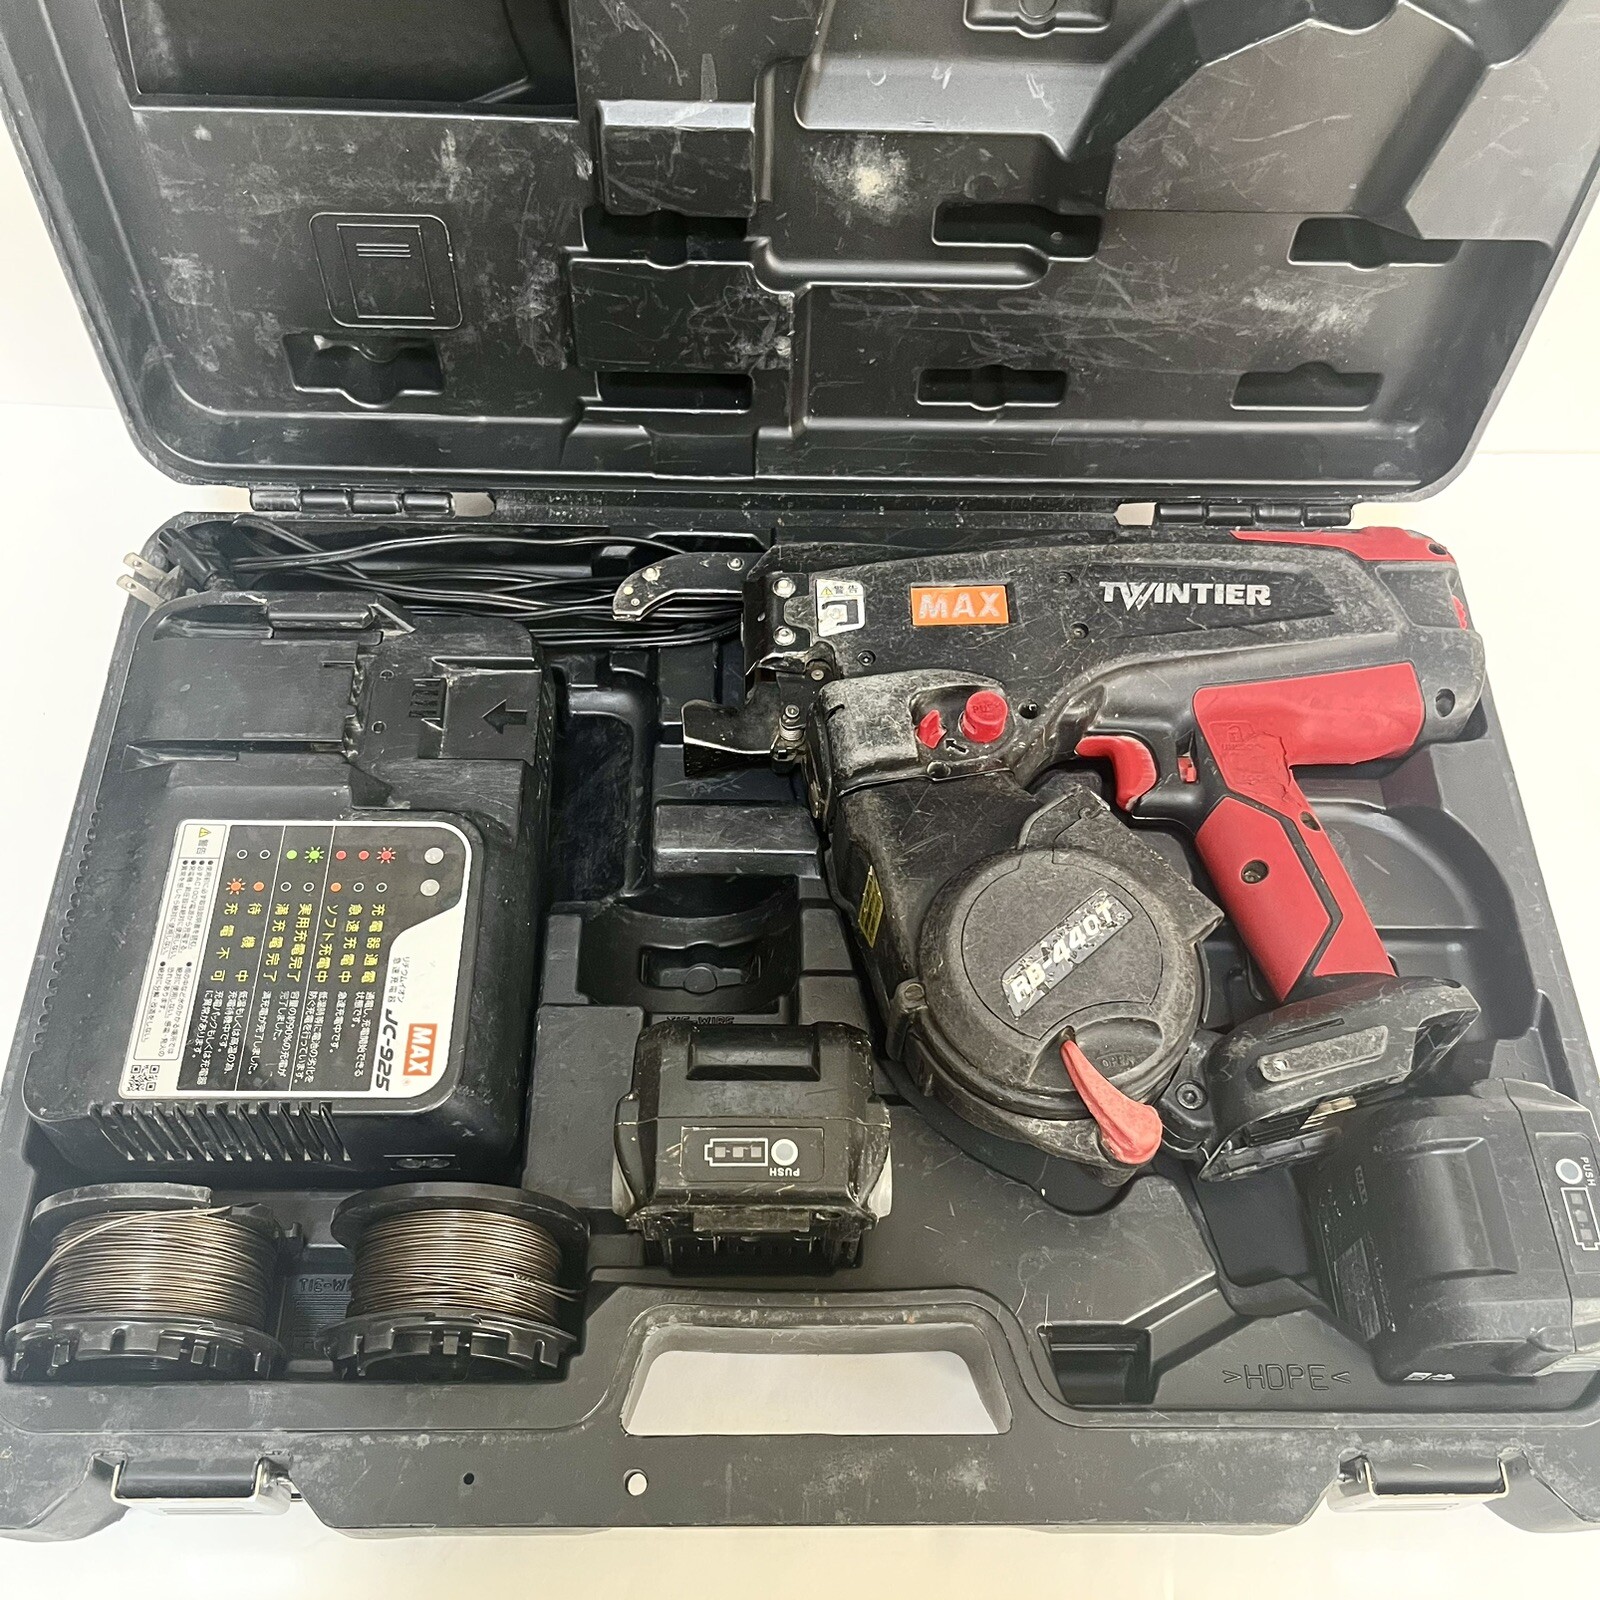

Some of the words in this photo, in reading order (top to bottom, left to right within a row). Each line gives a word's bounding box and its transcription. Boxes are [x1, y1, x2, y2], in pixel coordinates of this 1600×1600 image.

[918, 591, 1000, 619] MAX
[1099, 581, 1272, 612] TWINTIER
[210, 902, 239, 982] 充電不可
[234, 902, 263, 982] 待機中
[262, 903, 290, 982] 満充電完了
[286, 903, 313, 983] 実用充電完了
[314, 904, 339, 983] ソフト充電中
[338, 903, 363, 983] 急速充電中
[361, 903, 386, 983] 充電器通電
[387, 957, 402, 1003] 急速充電器
[397, 956, 410, 1004] リチウムイオン
[1009, 899, 1115, 1003] RB-440T
[375, 1008, 399, 1092] JC-925
[408, 1026, 433, 1073] MAX
[769, 1167, 800, 1177] PUSH
[1580, 1156, 1597, 1187] PUSH
[299, 1278, 347, 1292] TIE-W
